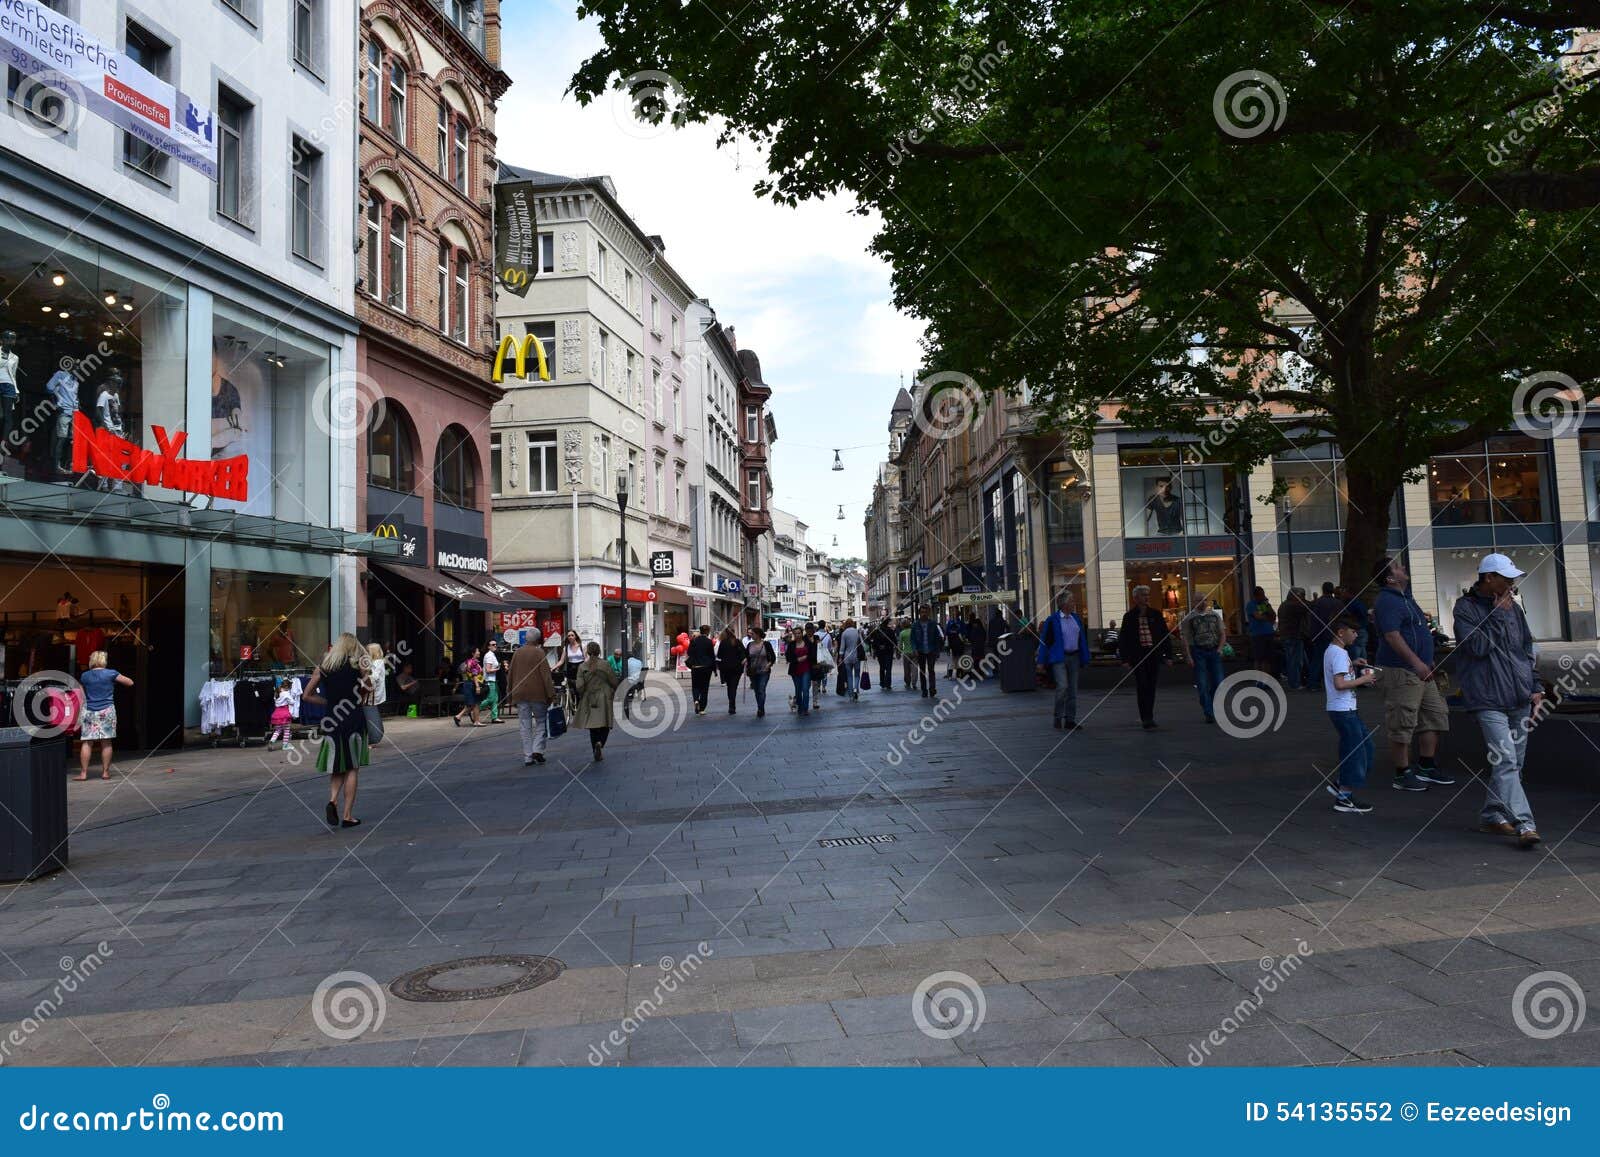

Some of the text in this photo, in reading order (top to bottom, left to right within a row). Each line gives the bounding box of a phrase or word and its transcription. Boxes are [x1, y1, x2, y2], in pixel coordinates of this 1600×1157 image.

[107, 82, 167, 123] Provisionsfrei
[504, 204, 521, 264] WILLKOMMEN
[520, 251, 533, 265] BEI
[438, 551, 488, 572] McDonald's
[503, 613, 534, 627] 50%
